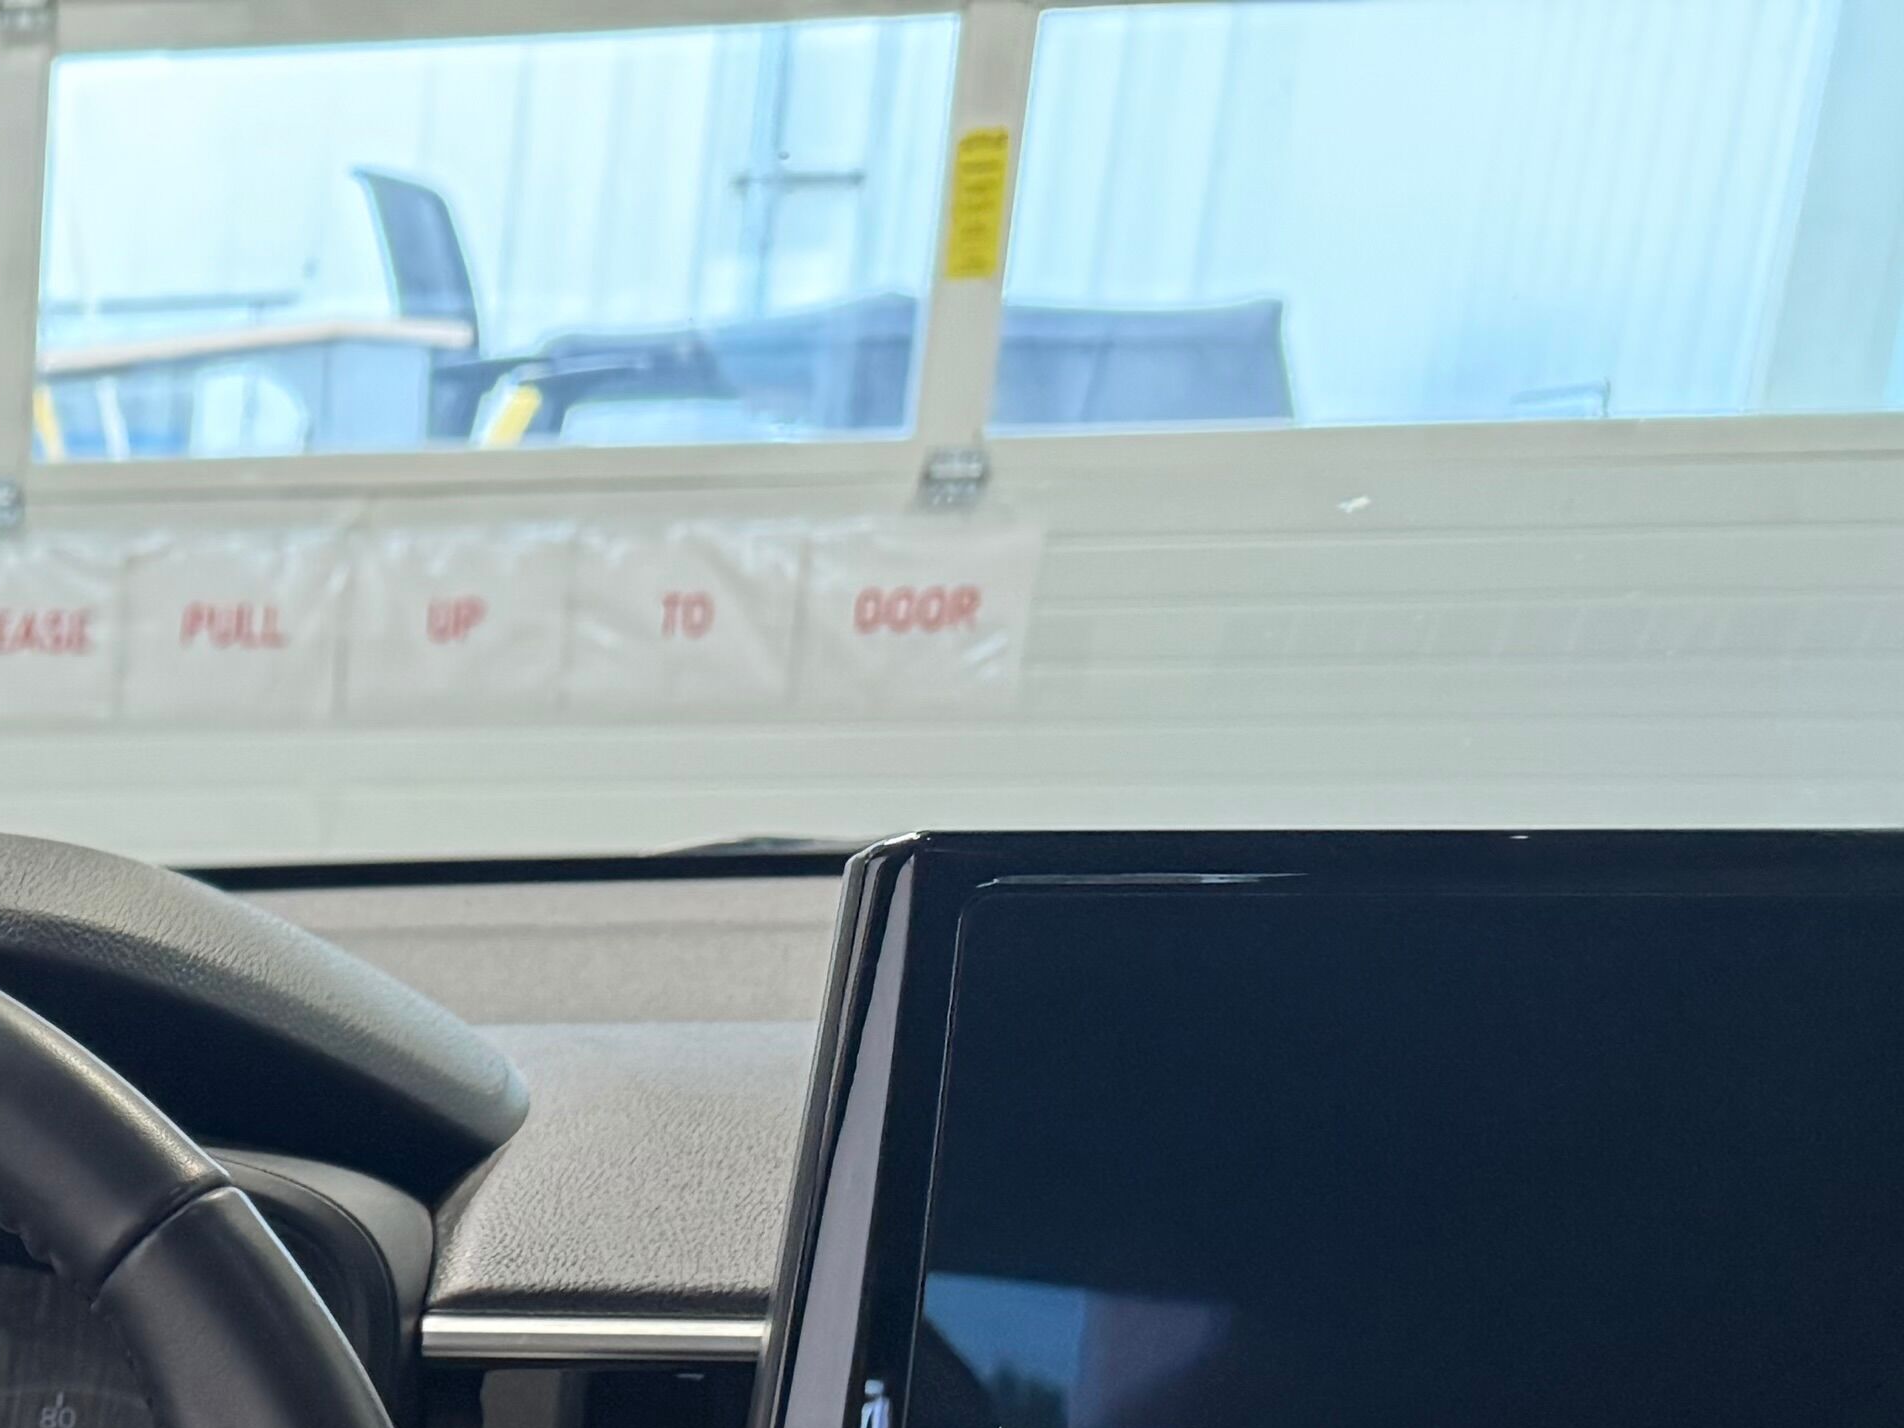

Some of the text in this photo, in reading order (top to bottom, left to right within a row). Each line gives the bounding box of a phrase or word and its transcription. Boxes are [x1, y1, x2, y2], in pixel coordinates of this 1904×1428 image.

[179, 602, 290, 649] PULL
[426, 595, 488, 644] UP
[661, 591, 715, 640] TO
[854, 585, 981, 635] DOOR
